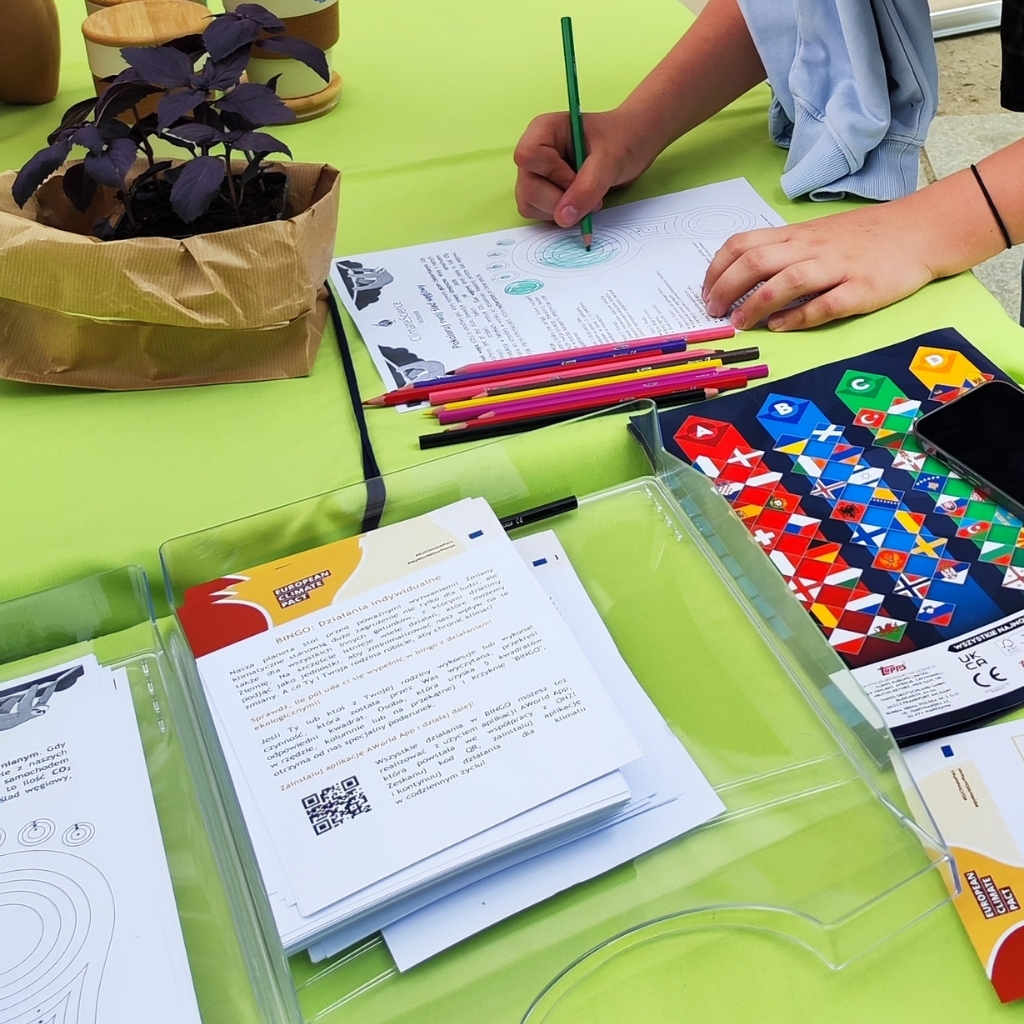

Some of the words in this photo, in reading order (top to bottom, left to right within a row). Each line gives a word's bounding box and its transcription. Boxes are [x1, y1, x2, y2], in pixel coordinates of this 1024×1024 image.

[924, 353, 945, 368] D
[851, 377, 871, 392] C
[775, 402, 795, 417] B
[696, 425, 716, 438] A
[274, 570, 329, 595] EUROPEAN
[278, 580, 323, 601] CLIMATE
[275, 625, 316, 645] BINGO:
[317, 604, 369, 628] Działania
[370, 575, 442, 607] indywidualne
[281, 593, 307, 608] PACT
[953, 629, 998, 650] WSZYSTKIE
[957, 650, 981, 664] UK
[964, 657, 989, 671] CA
[260, 732, 281, 746] Jeśli
[286, 725, 299, 733] Ty
[305, 716, 321, 726] lub
[326, 704, 346, 717] ktoś
[362, 684, 395, 700] Twojej
[400, 668, 431, 686] rodziny
[436, 649, 477, 669] wykonuje
[481, 641, 496, 650] lub
[500, 624, 534, 642] wykonał
[263, 730, 308, 753] czynność,
[316, 716, 341, 730] która
[349, 699, 381, 716] została
[389, 685, 413, 700] przez
[420, 674, 440, 685] Was
[446, 652, 494, 674] wyczytana,
[501, 630, 539, 651] przekreśl
[266, 734, 319, 761] odpowiedni
[327, 715, 368, 734] kwadrat.
[377, 698, 408, 713] Osoba,
[415, 683, 440, 696] która
[447, 667, 476, 682] uzyska
[497, 638, 543, 660] kwadratów
[280, 746, 318, 765] rzędzie,
[323, 723, 366, 745] kolumnie
[371, 715, 387, 724] lub
[392, 707, 404, 715] na
[410, 683, 456, 709] przekątnej
[470, 662, 506, 681] krzyknie
[511, 645, 547, 662] "BINGO",
[374, 743, 418, 766] Wszystkie
[425, 723, 464, 744] działania
[483, 701, 512, 718] BINGO
[517, 686, 548, 703] możesz
[553, 677, 567, 687] też
[46, 741, 66, 753] Gdy
[273, 757, 312, 777] otrzyma
[313, 749, 325, 760] od
[326, 743, 343, 754] nas
[344, 723, 386, 746] specjalny
[387, 703, 437, 728] podarunek.
[279, 767, 324, 792] Zainstaluj
[325, 750, 365, 771] aplikację
[366, 735, 398, 754] AWorld
[399, 728, 416, 739] App
[422, 712, 451, 728] działaj
[451, 700, 475, 715] dalej!
[382, 767, 408, 782] która
[416, 745, 456, 768] powstała
[464, 735, 478, 745] we
[486, 711, 533, 735] współpracy
[555, 691, 577, 704] ONZ!
[386, 767, 428, 790] Zeskanuj
[437, 754, 455, 766] kod
[465, 743, 482, 754] QR,
[491, 719, 534, 742] zainstaluj
[544, 699, 582, 719] aplikację
[28, 749, 68, 768] naszych
[395, 770, 443, 795] kontynuuj
[462, 744, 502, 765] działania
[521, 729, 536, 738] dla
[553, 706, 587, 724] klimatu
[3, 757, 70, 785] samochodem
[5, 784, 18, 793] to
[966, 872, 995, 918] EUROPEAN
[982, 877, 1006, 914] CLIMATE
[1000, 888, 1019, 911] PACT
